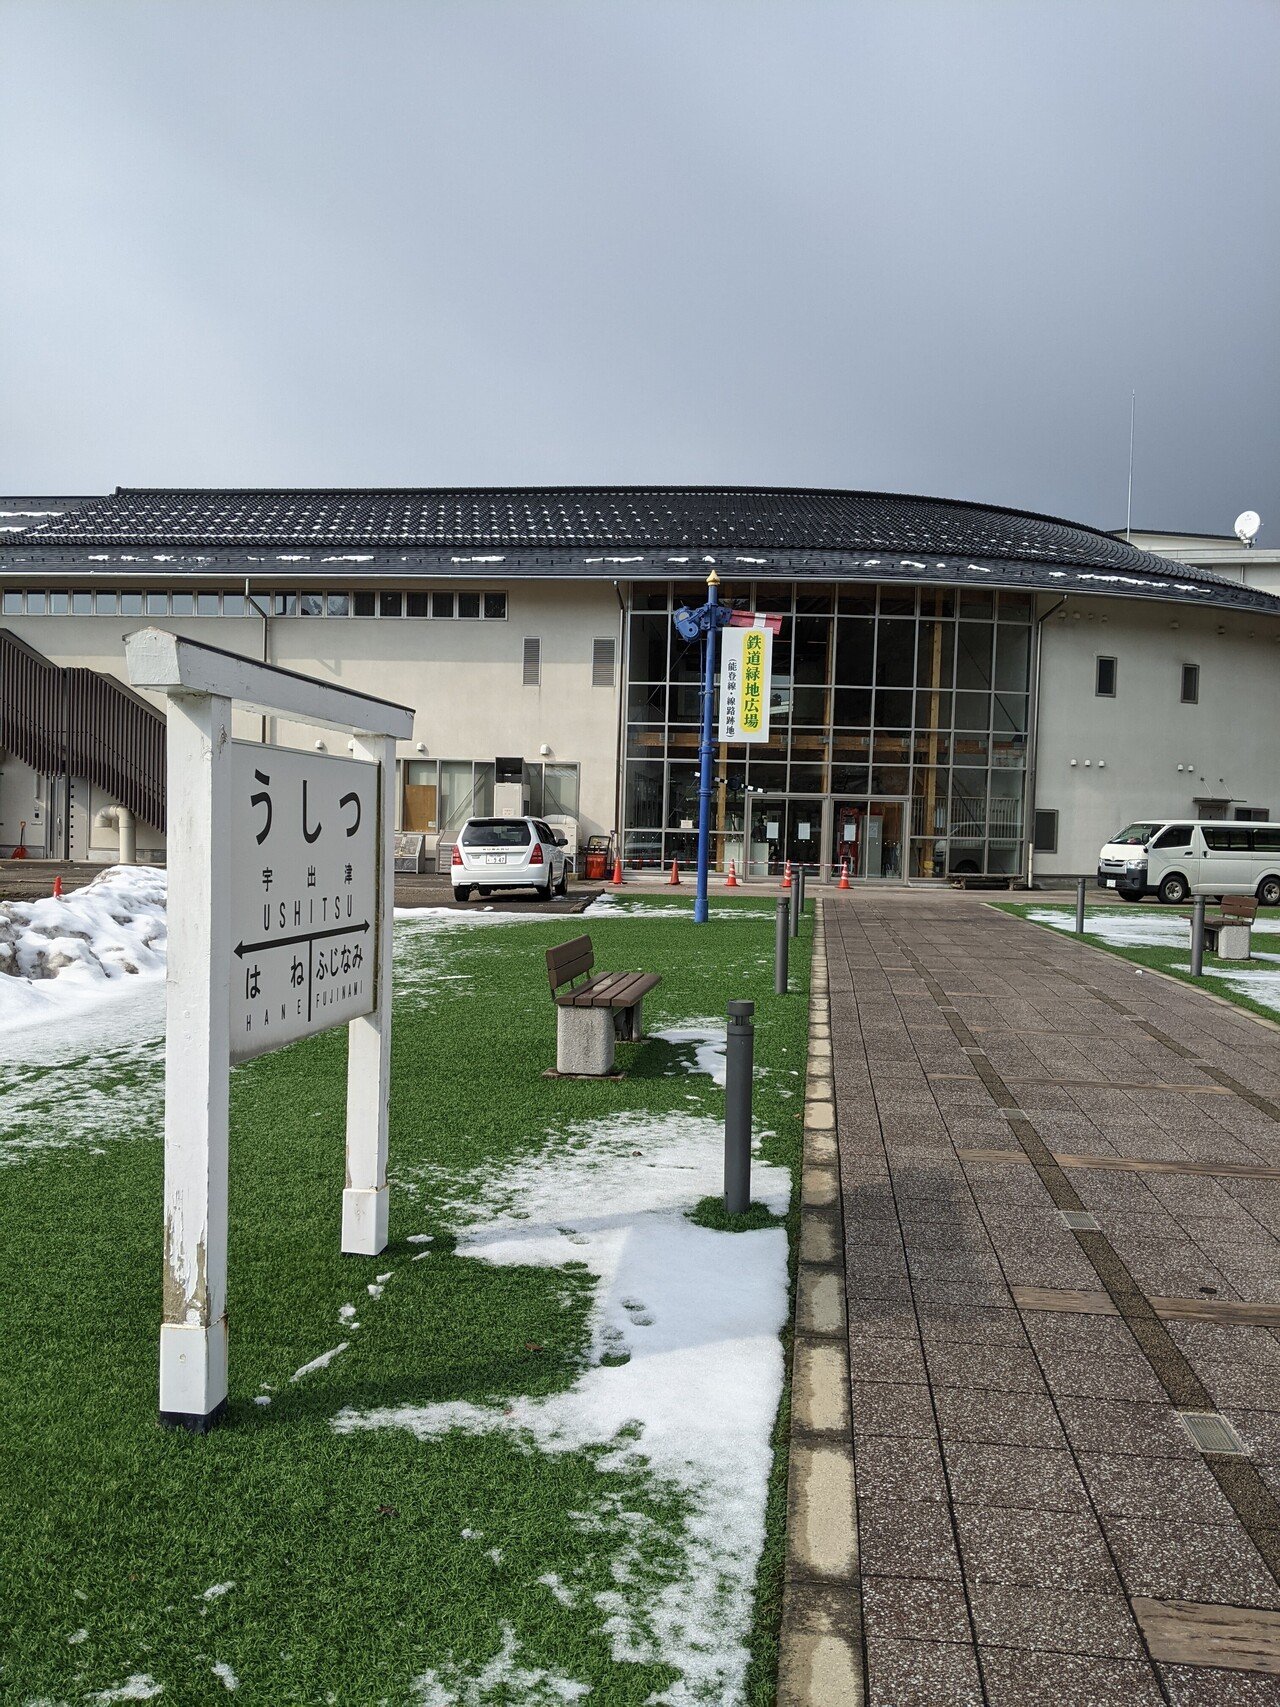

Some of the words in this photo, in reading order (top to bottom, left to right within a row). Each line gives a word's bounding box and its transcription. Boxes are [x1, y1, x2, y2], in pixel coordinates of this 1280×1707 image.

[743, 634, 761, 729] 鉄道緑地広場
[250, 769, 361, 845] うしつ
[262, 862, 353, 892] 宇出津
[263, 894, 353, 931] USHITSU
[315, 943, 364, 980] ふじなみ
[315, 980, 363, 1009] FUJINAMI
[246, 999, 302, 1032] HANE
